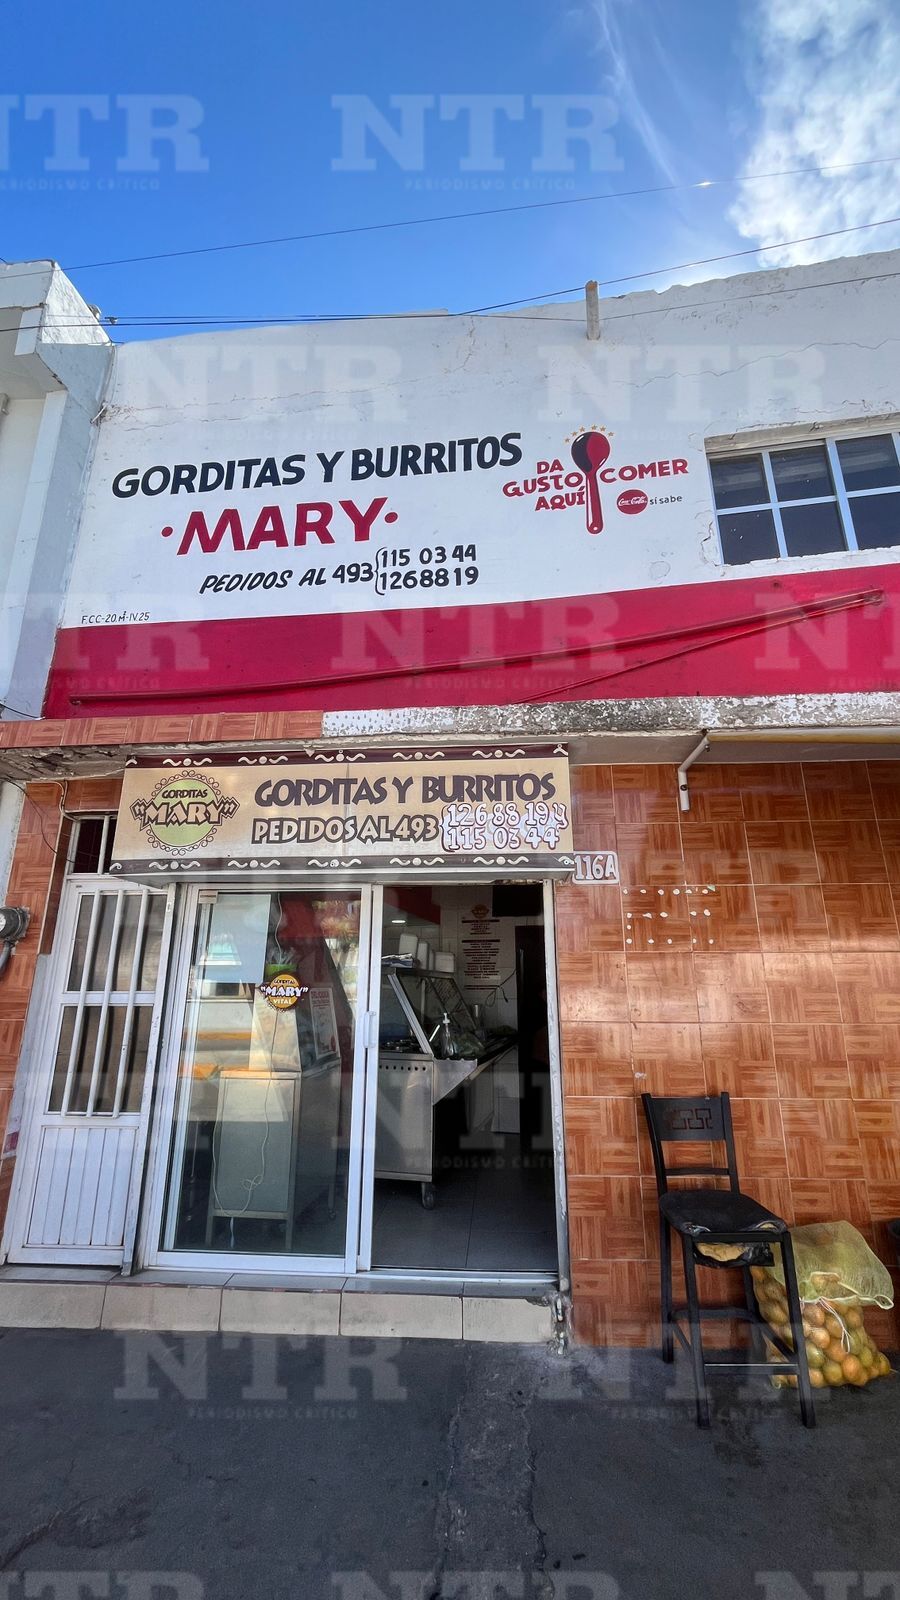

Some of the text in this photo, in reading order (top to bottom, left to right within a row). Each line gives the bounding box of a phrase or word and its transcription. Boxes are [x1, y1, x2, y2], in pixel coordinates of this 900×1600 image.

[112, 432, 522, 498] GORDITAS Y BURRITOS
[536, 459, 564, 475] DA
[502, 459, 689, 498] GUSTO COMER
[535, 486, 585, 511] AQUÍ
[659, 495, 683, 504] sabe
[381, 549, 410, 568] 115
[452, 544, 477, 562] 44
[199, 562, 374, 594] PEDIDOS AL 493
[162, 789, 208, 799] GORDITAS
[254, 772, 556, 807] GORDITAS Y BURRITOS
[448, 802, 488, 827] 126
[251, 814, 439, 844] PEDIDOS AL 493
[448, 827, 487, 849] 115
[524, 827, 560, 849] 44
[574, 855, 618, 881] 116A
